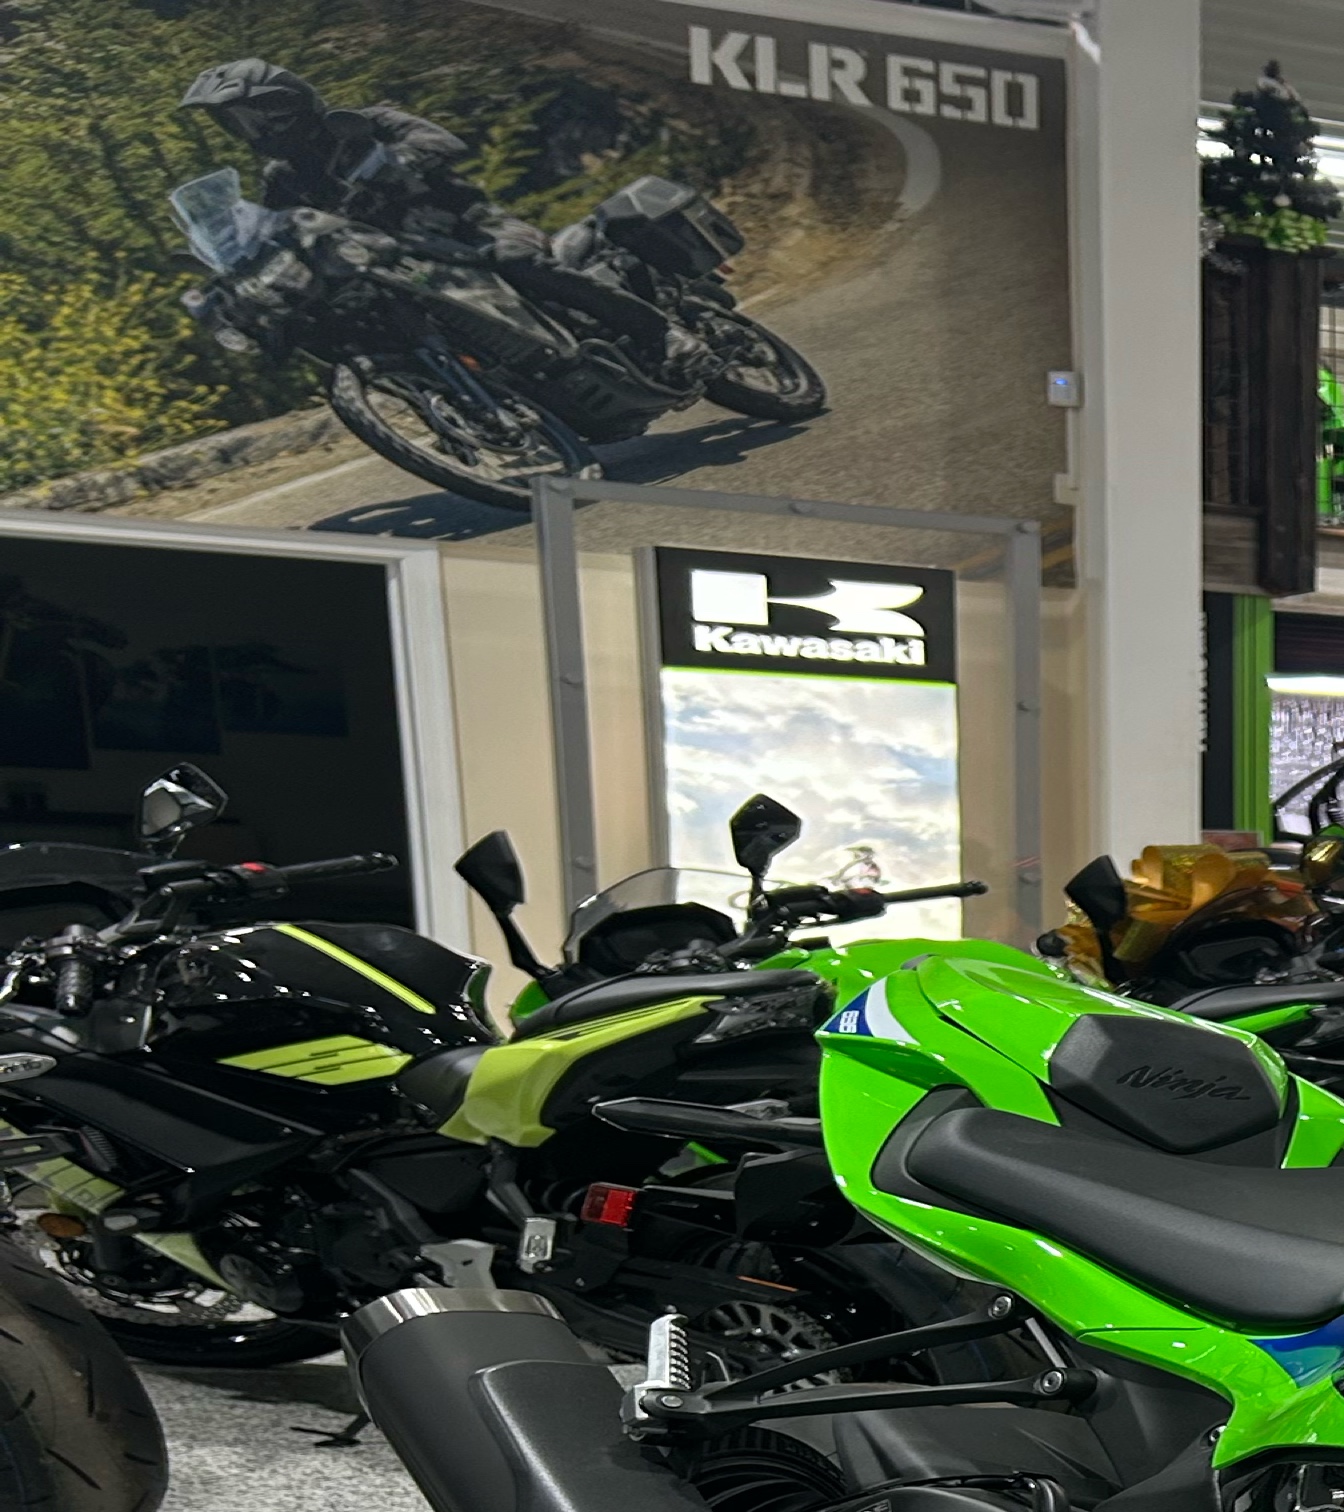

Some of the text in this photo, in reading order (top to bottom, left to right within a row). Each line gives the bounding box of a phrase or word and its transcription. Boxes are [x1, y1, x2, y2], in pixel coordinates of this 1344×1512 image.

[688, 25, 1041, 131] KLR 650
[693, 623, 927, 666] Kawasaki
[1116, 1065, 1251, 1101] Ninja
